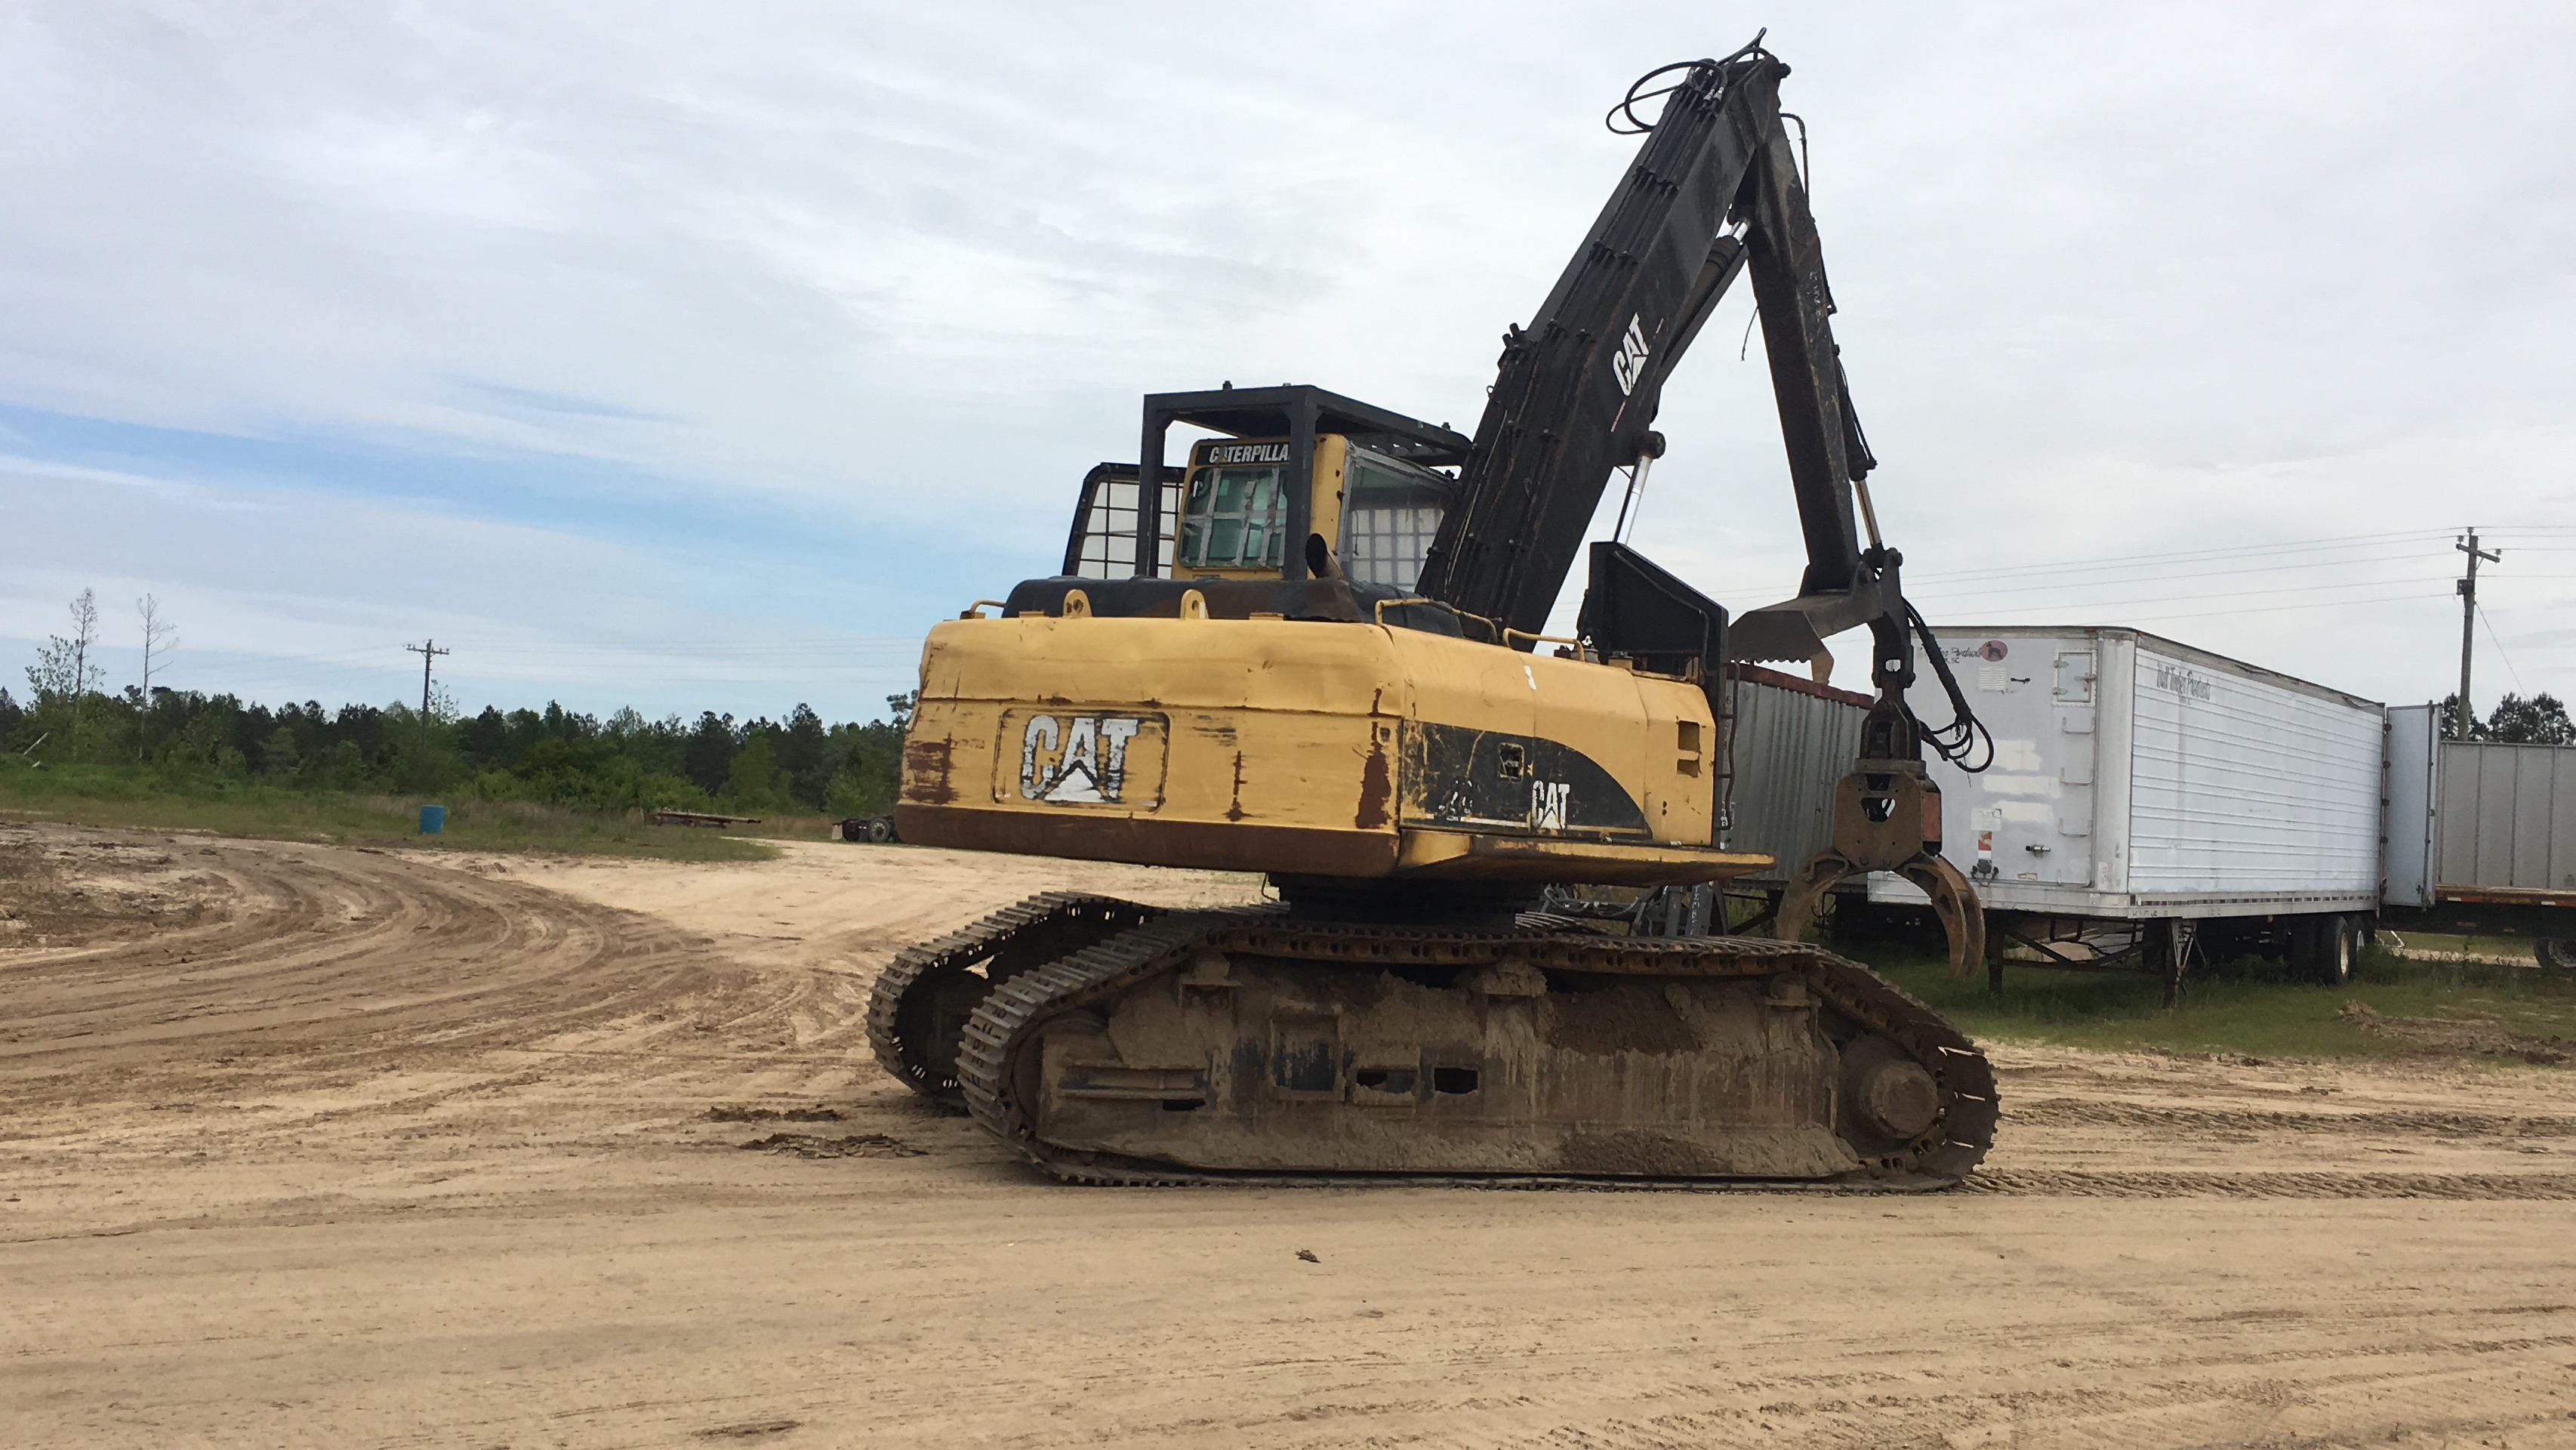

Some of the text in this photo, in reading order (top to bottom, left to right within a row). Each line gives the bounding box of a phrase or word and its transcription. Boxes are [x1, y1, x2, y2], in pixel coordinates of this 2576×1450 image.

[1613, 311, 1650, 396] CAT
[1209, 443, 1290, 464] CTERPILLA
[1021, 715, 1139, 803] CAT
[1532, 780, 1570, 830] CAT
